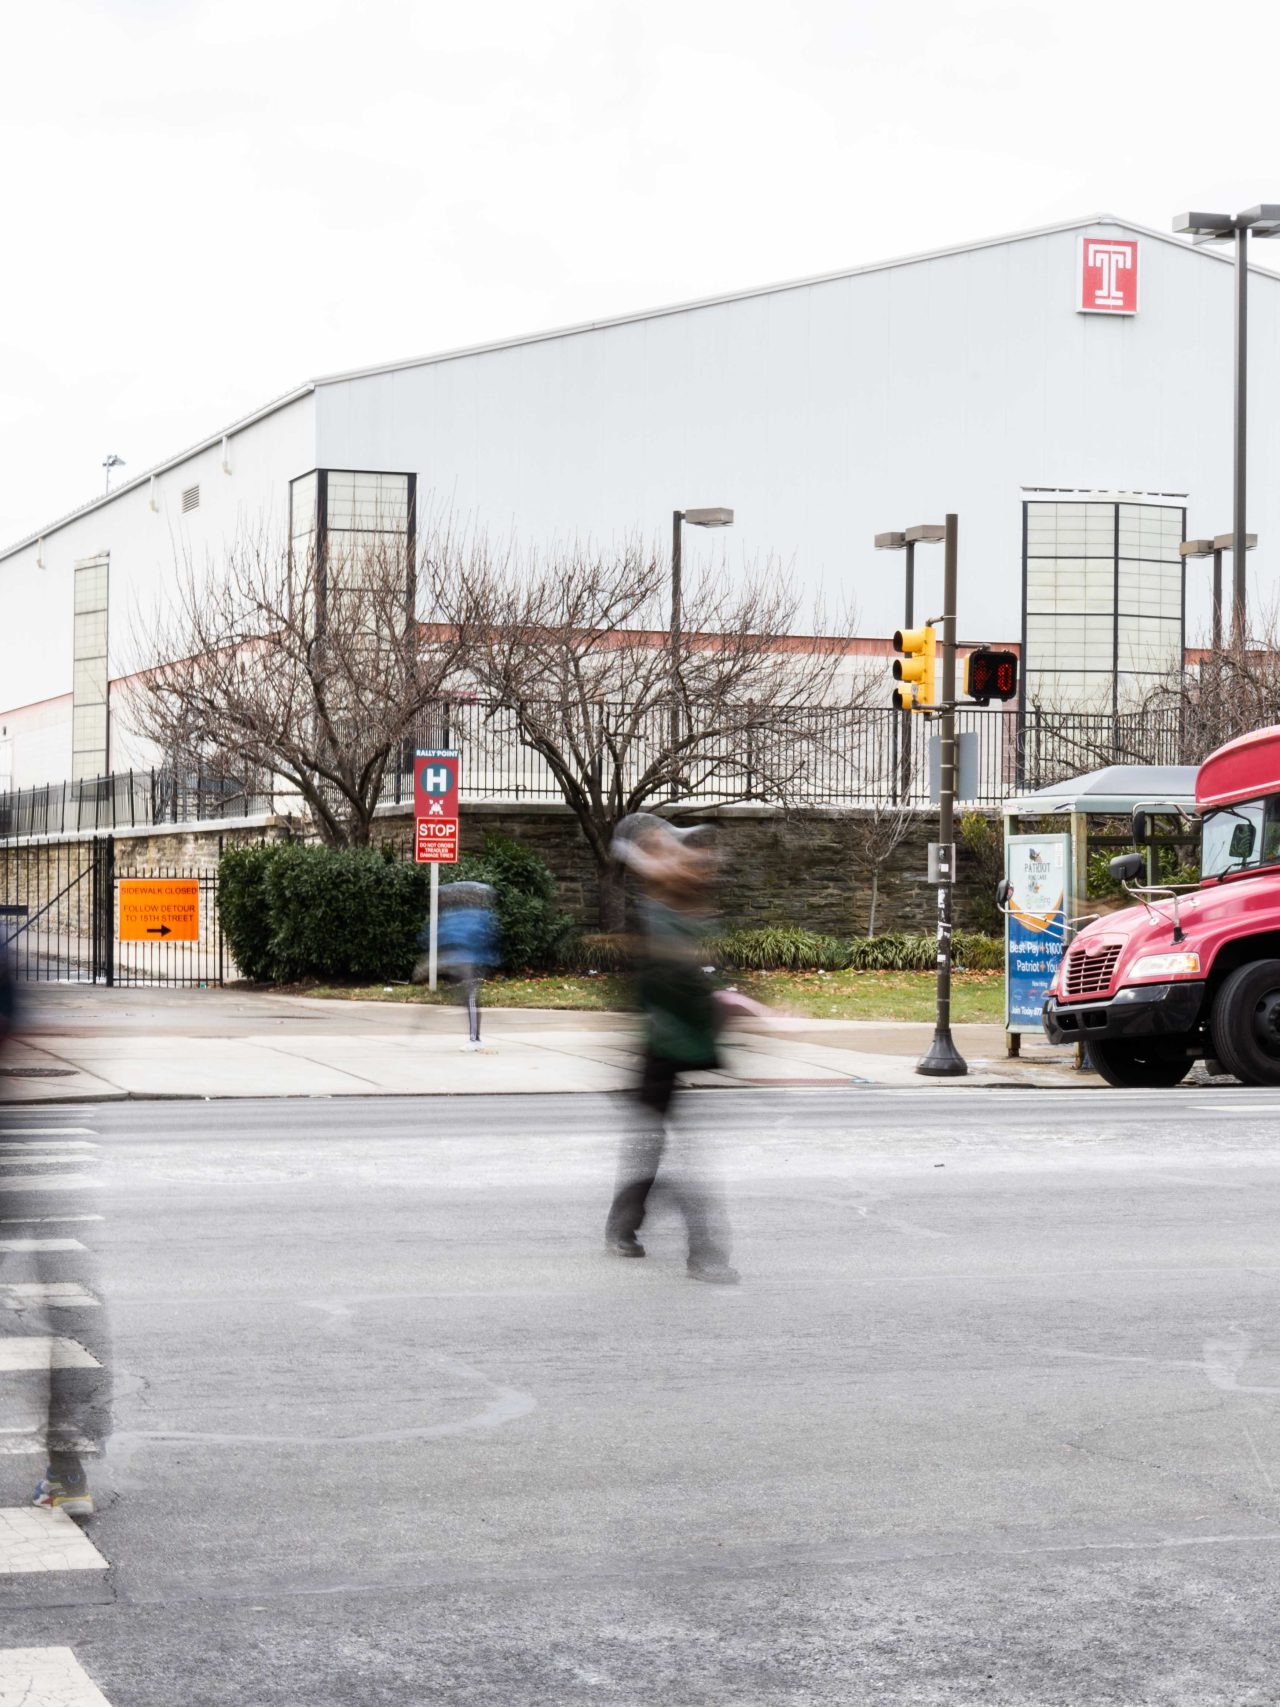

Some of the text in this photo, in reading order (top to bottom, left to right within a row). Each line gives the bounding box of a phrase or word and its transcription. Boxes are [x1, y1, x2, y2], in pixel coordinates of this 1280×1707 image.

[1088, 244, 1132, 306] T
[416, 749, 436, 757] RALLY
[426, 768, 447, 792] H
[419, 824, 456, 837] STOP
[1024, 863, 1051, 873] PATRIOT
[121, 887, 197, 895] SIDEWALK CLOSED
[1009, 941, 1026, 954] Best
[1027, 942, 1040, 956] Pay
[1016, 960, 1040, 973] Patriot
